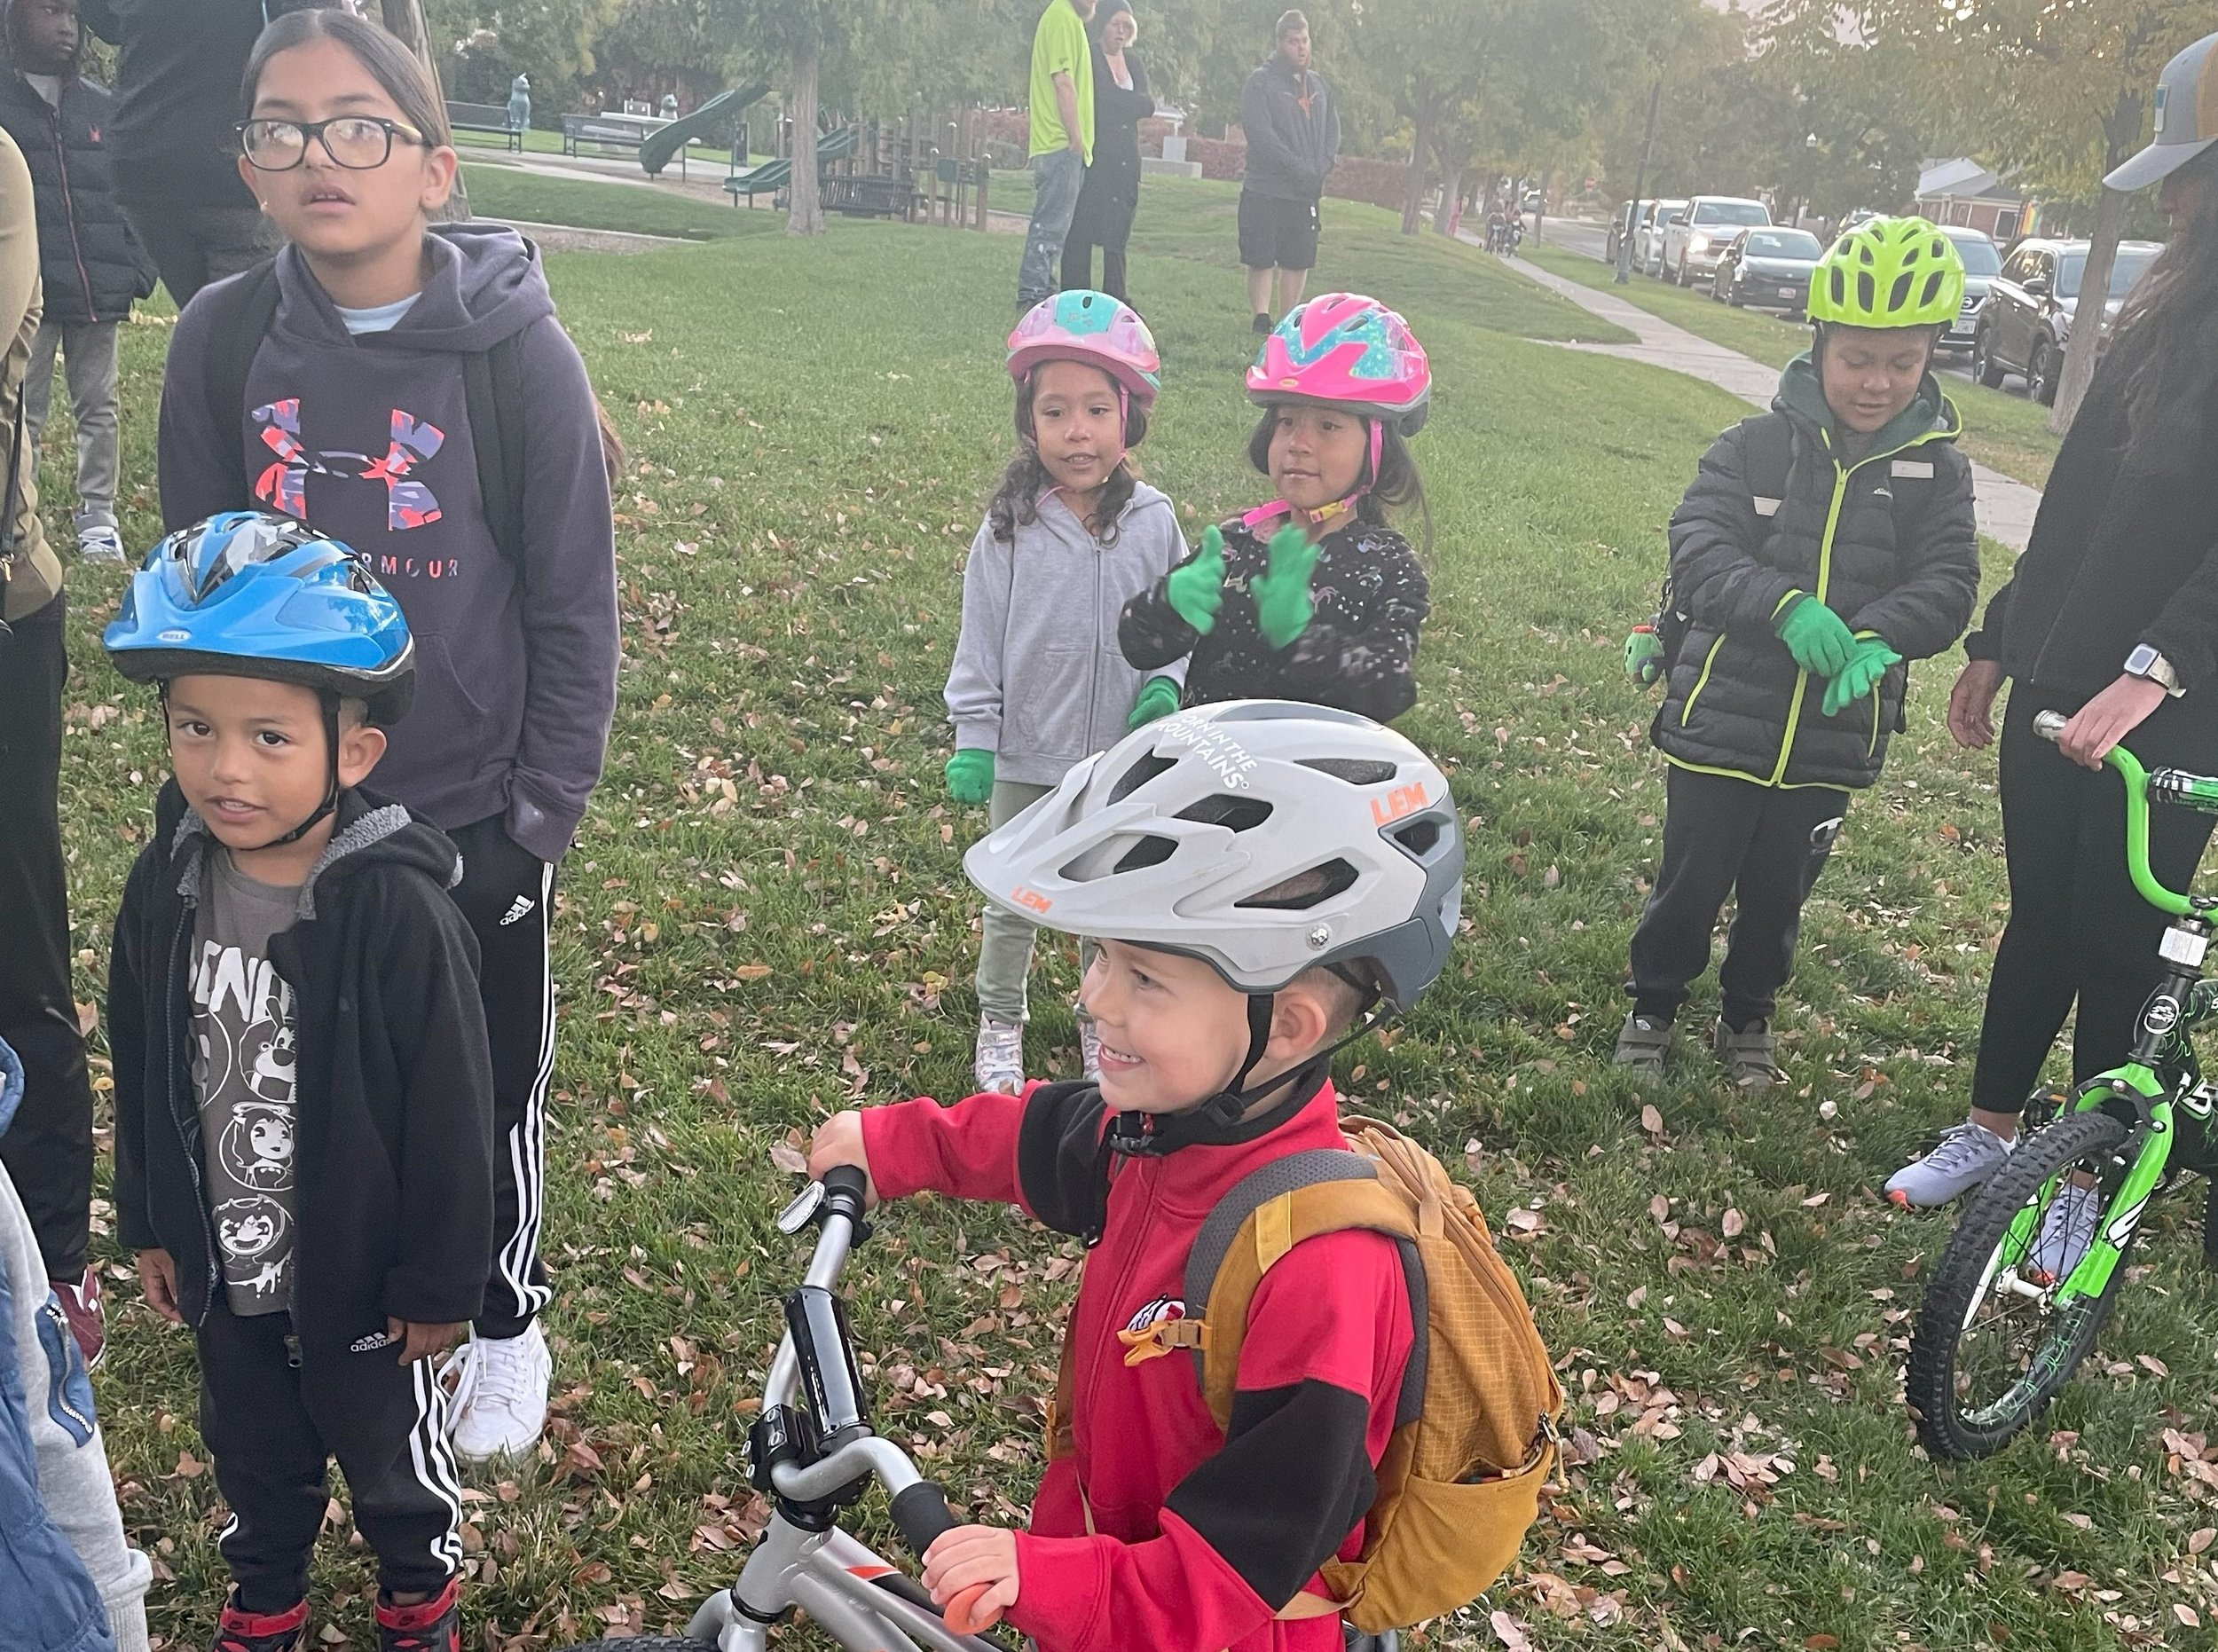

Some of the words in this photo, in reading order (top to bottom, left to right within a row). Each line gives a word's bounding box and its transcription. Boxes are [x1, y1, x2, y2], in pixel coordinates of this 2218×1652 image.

[358, 552, 458, 578] RMOUR
[1207, 729, 1232, 745] IN
[1224, 742, 1258, 772] THE
[1370, 782, 1428, 826] LEM
[1011, 886, 1053, 914] LEM
